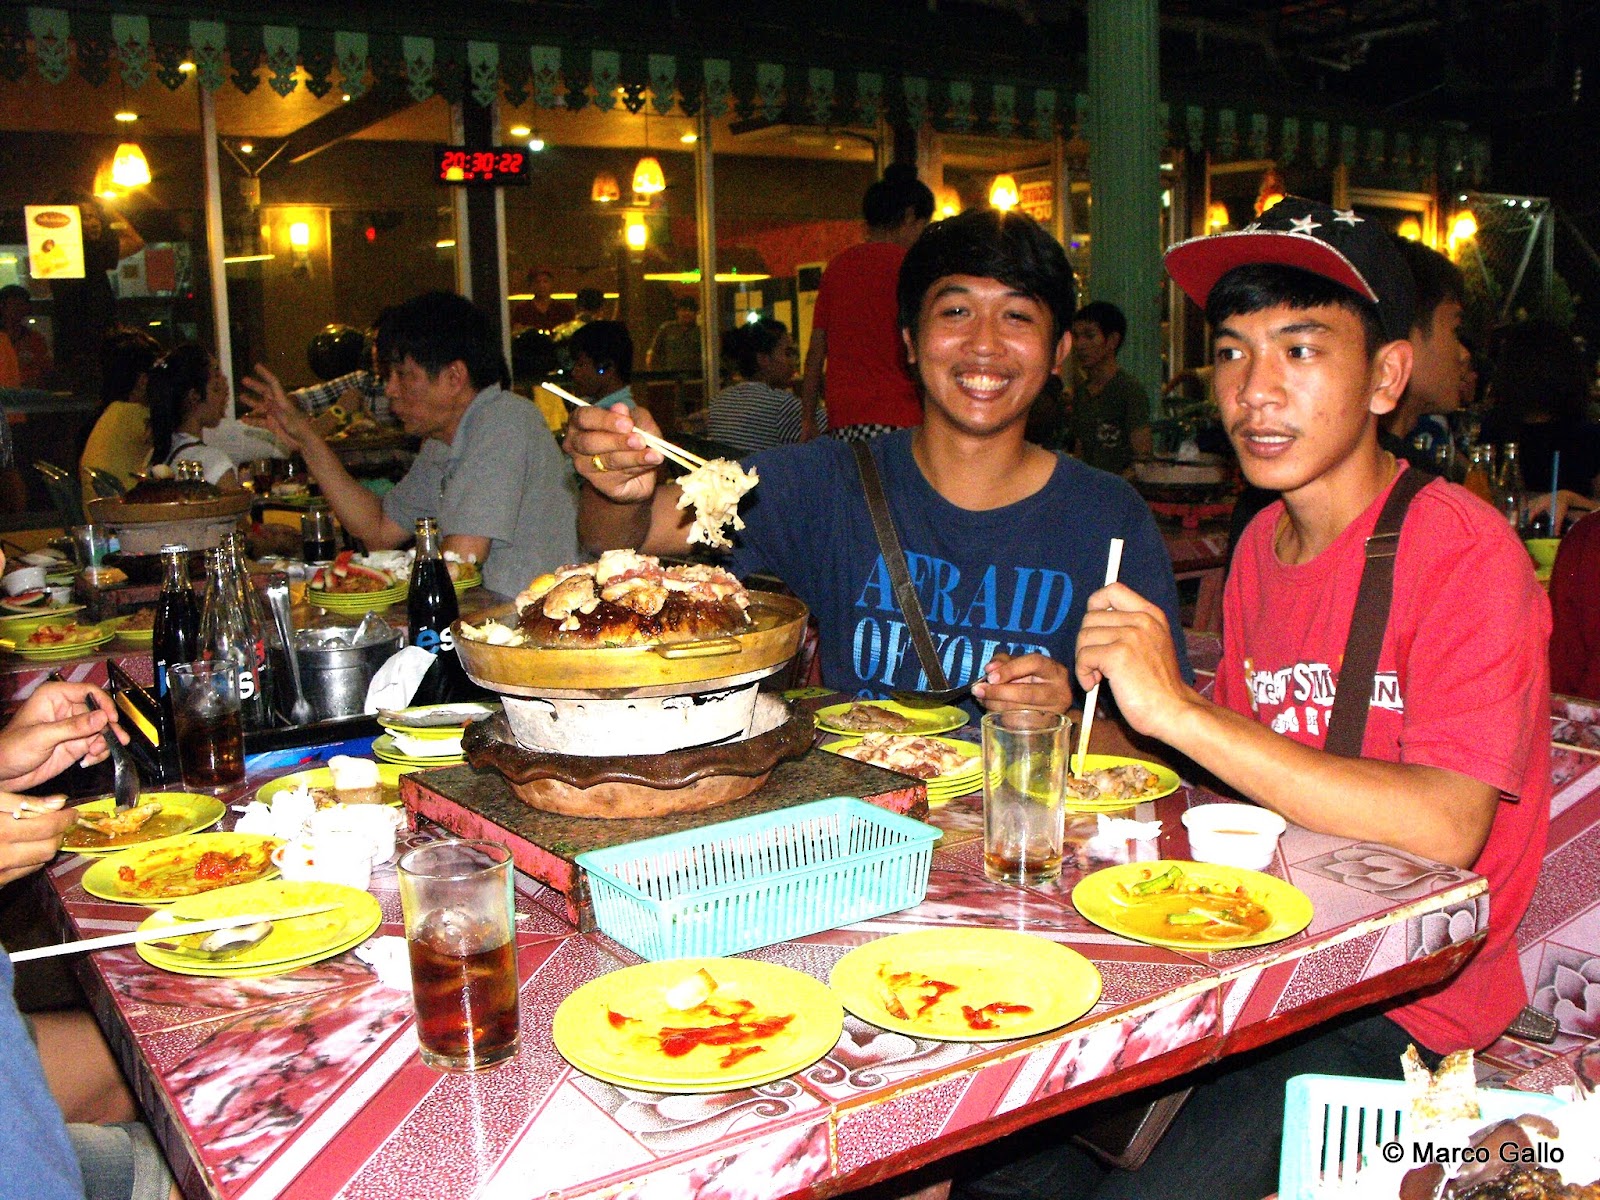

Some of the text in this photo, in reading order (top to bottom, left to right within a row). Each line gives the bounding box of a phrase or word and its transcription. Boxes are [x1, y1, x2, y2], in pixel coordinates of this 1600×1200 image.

[441, 151, 524, 173] 20:30:22
[855, 550, 1073, 635] AFRAID
[853, 617, 1050, 691] OF YOU
